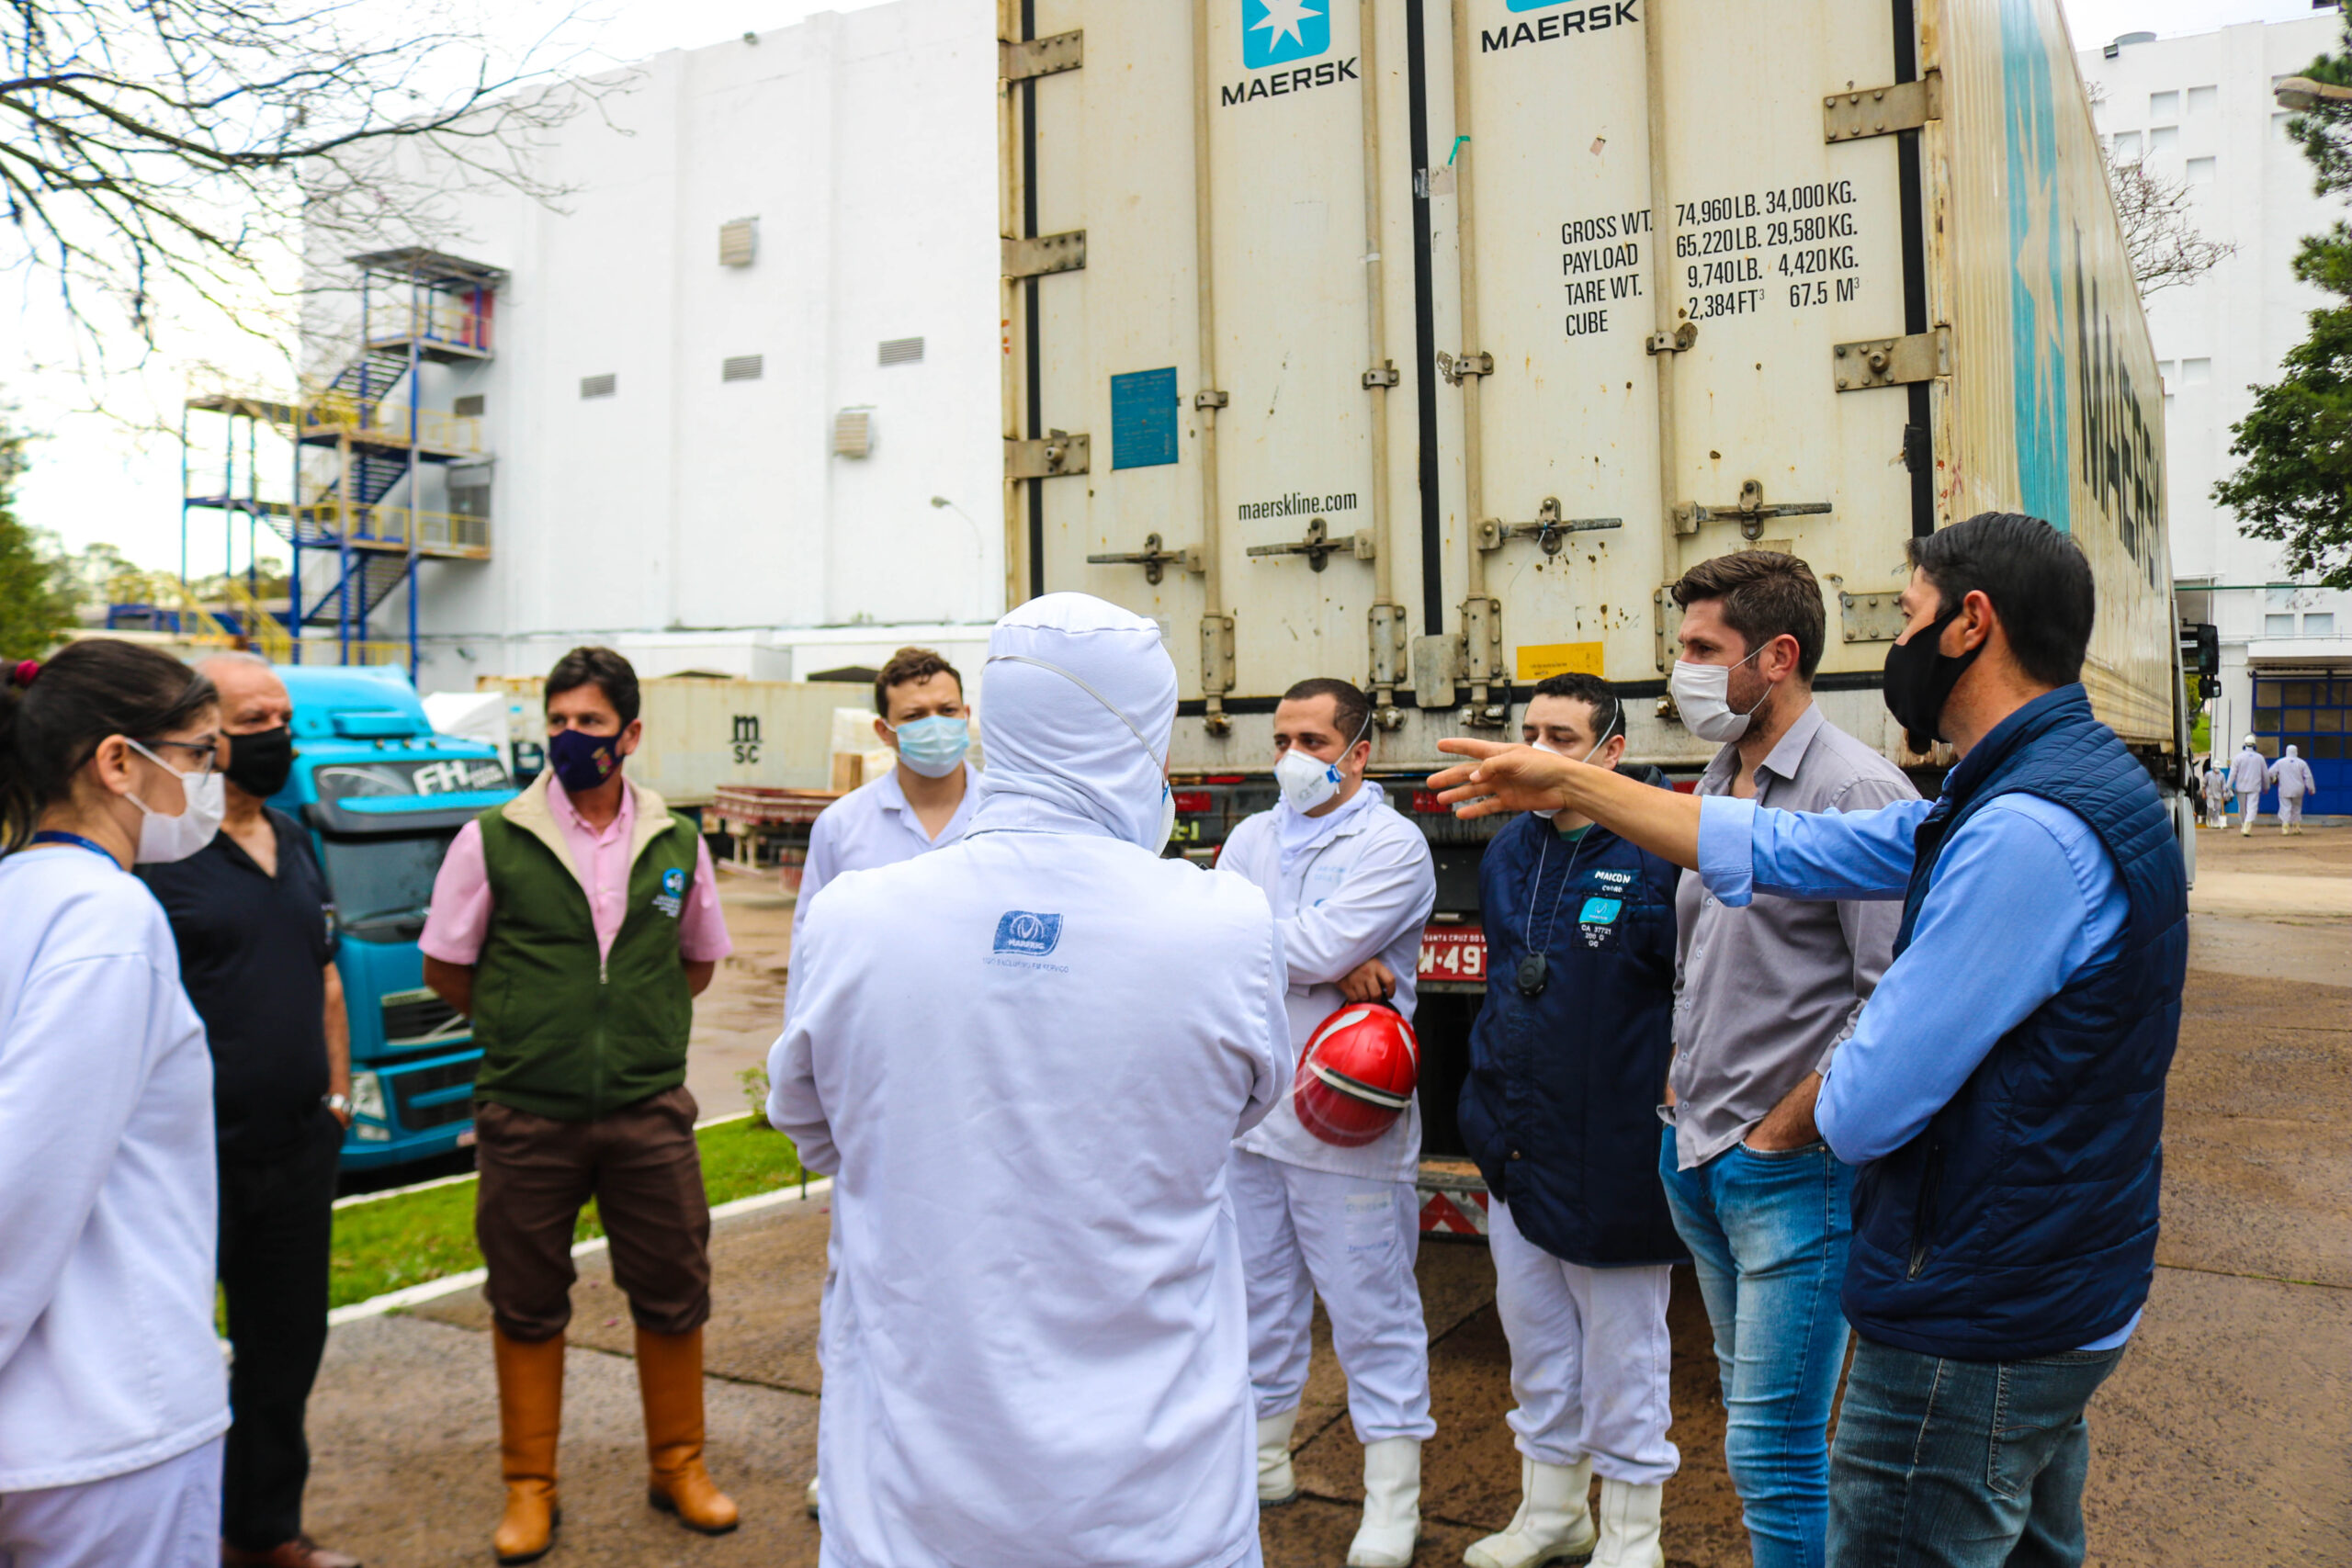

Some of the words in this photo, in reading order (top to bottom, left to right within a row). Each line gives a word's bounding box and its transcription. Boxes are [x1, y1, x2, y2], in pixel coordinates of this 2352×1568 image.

[1481, 0, 1639, 53] MAERSK
[1221, 56, 1359, 107] MAERSK
[1562, 216, 1617, 244] GROSS
[1621, 209, 1653, 235] WT.
[1563, 243, 1638, 276] PAYLOAD
[1565, 279, 1606, 306] TARE
[1610, 274, 1643, 299] WT.
[1566, 310, 1608, 337] CUBE
[1790, 280, 1827, 308] 67.5
[1238, 492, 1358, 521] maerskline.com
[1595, 871, 1631, 884] MAICON
